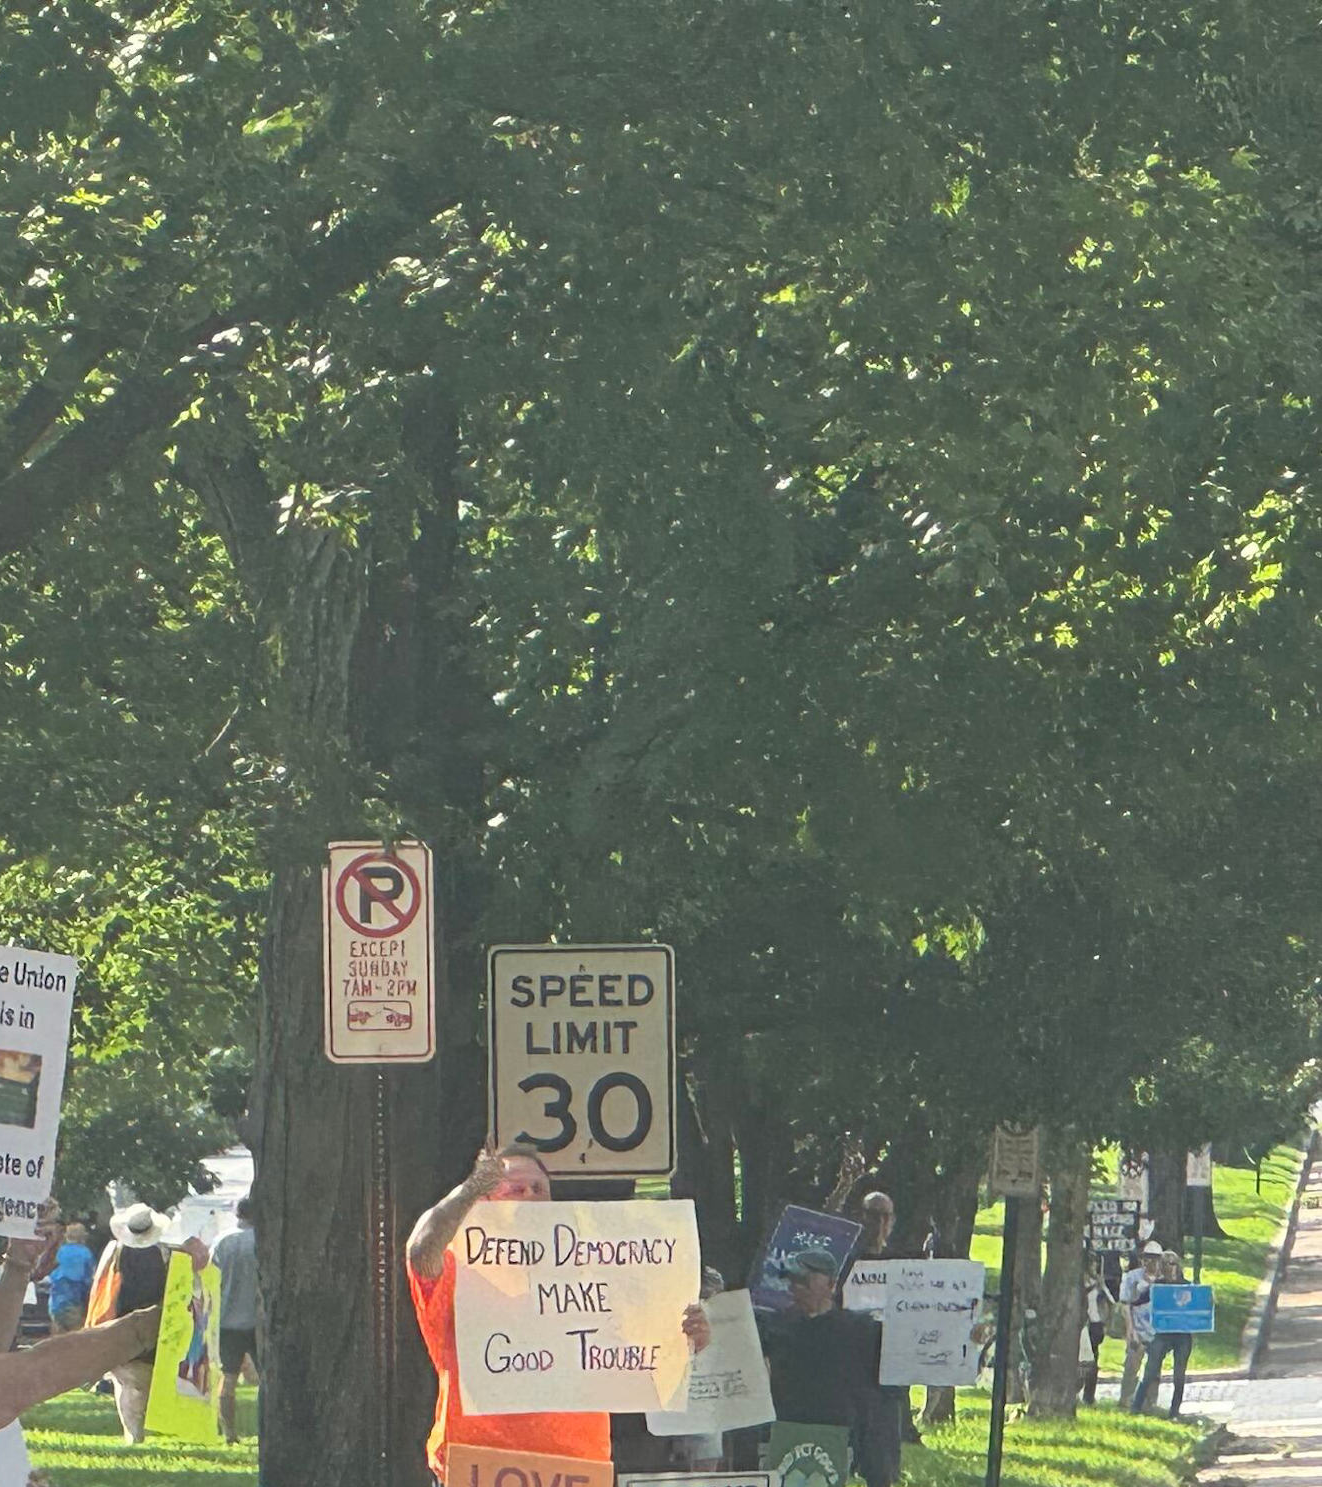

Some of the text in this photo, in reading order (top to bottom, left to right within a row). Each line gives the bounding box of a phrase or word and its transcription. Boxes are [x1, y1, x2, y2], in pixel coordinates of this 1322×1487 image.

[350, 940, 405, 957] EXCEPT
[15, 962, 67, 992] Union
[349, 960, 408, 977] SUNDAY
[343, 979, 372, 996] 7AM
[387, 979, 417, 996] 2PM
[510, 974, 654, 1008] SPEED
[0, 1001, 34, 1029] is in
[526, 1021, 637, 1055] LIMIT
[514, 1071, 653, 1153] 30
[26, 1156, 44, 1178] of
[538, 1282, 612, 1315] MAKE
